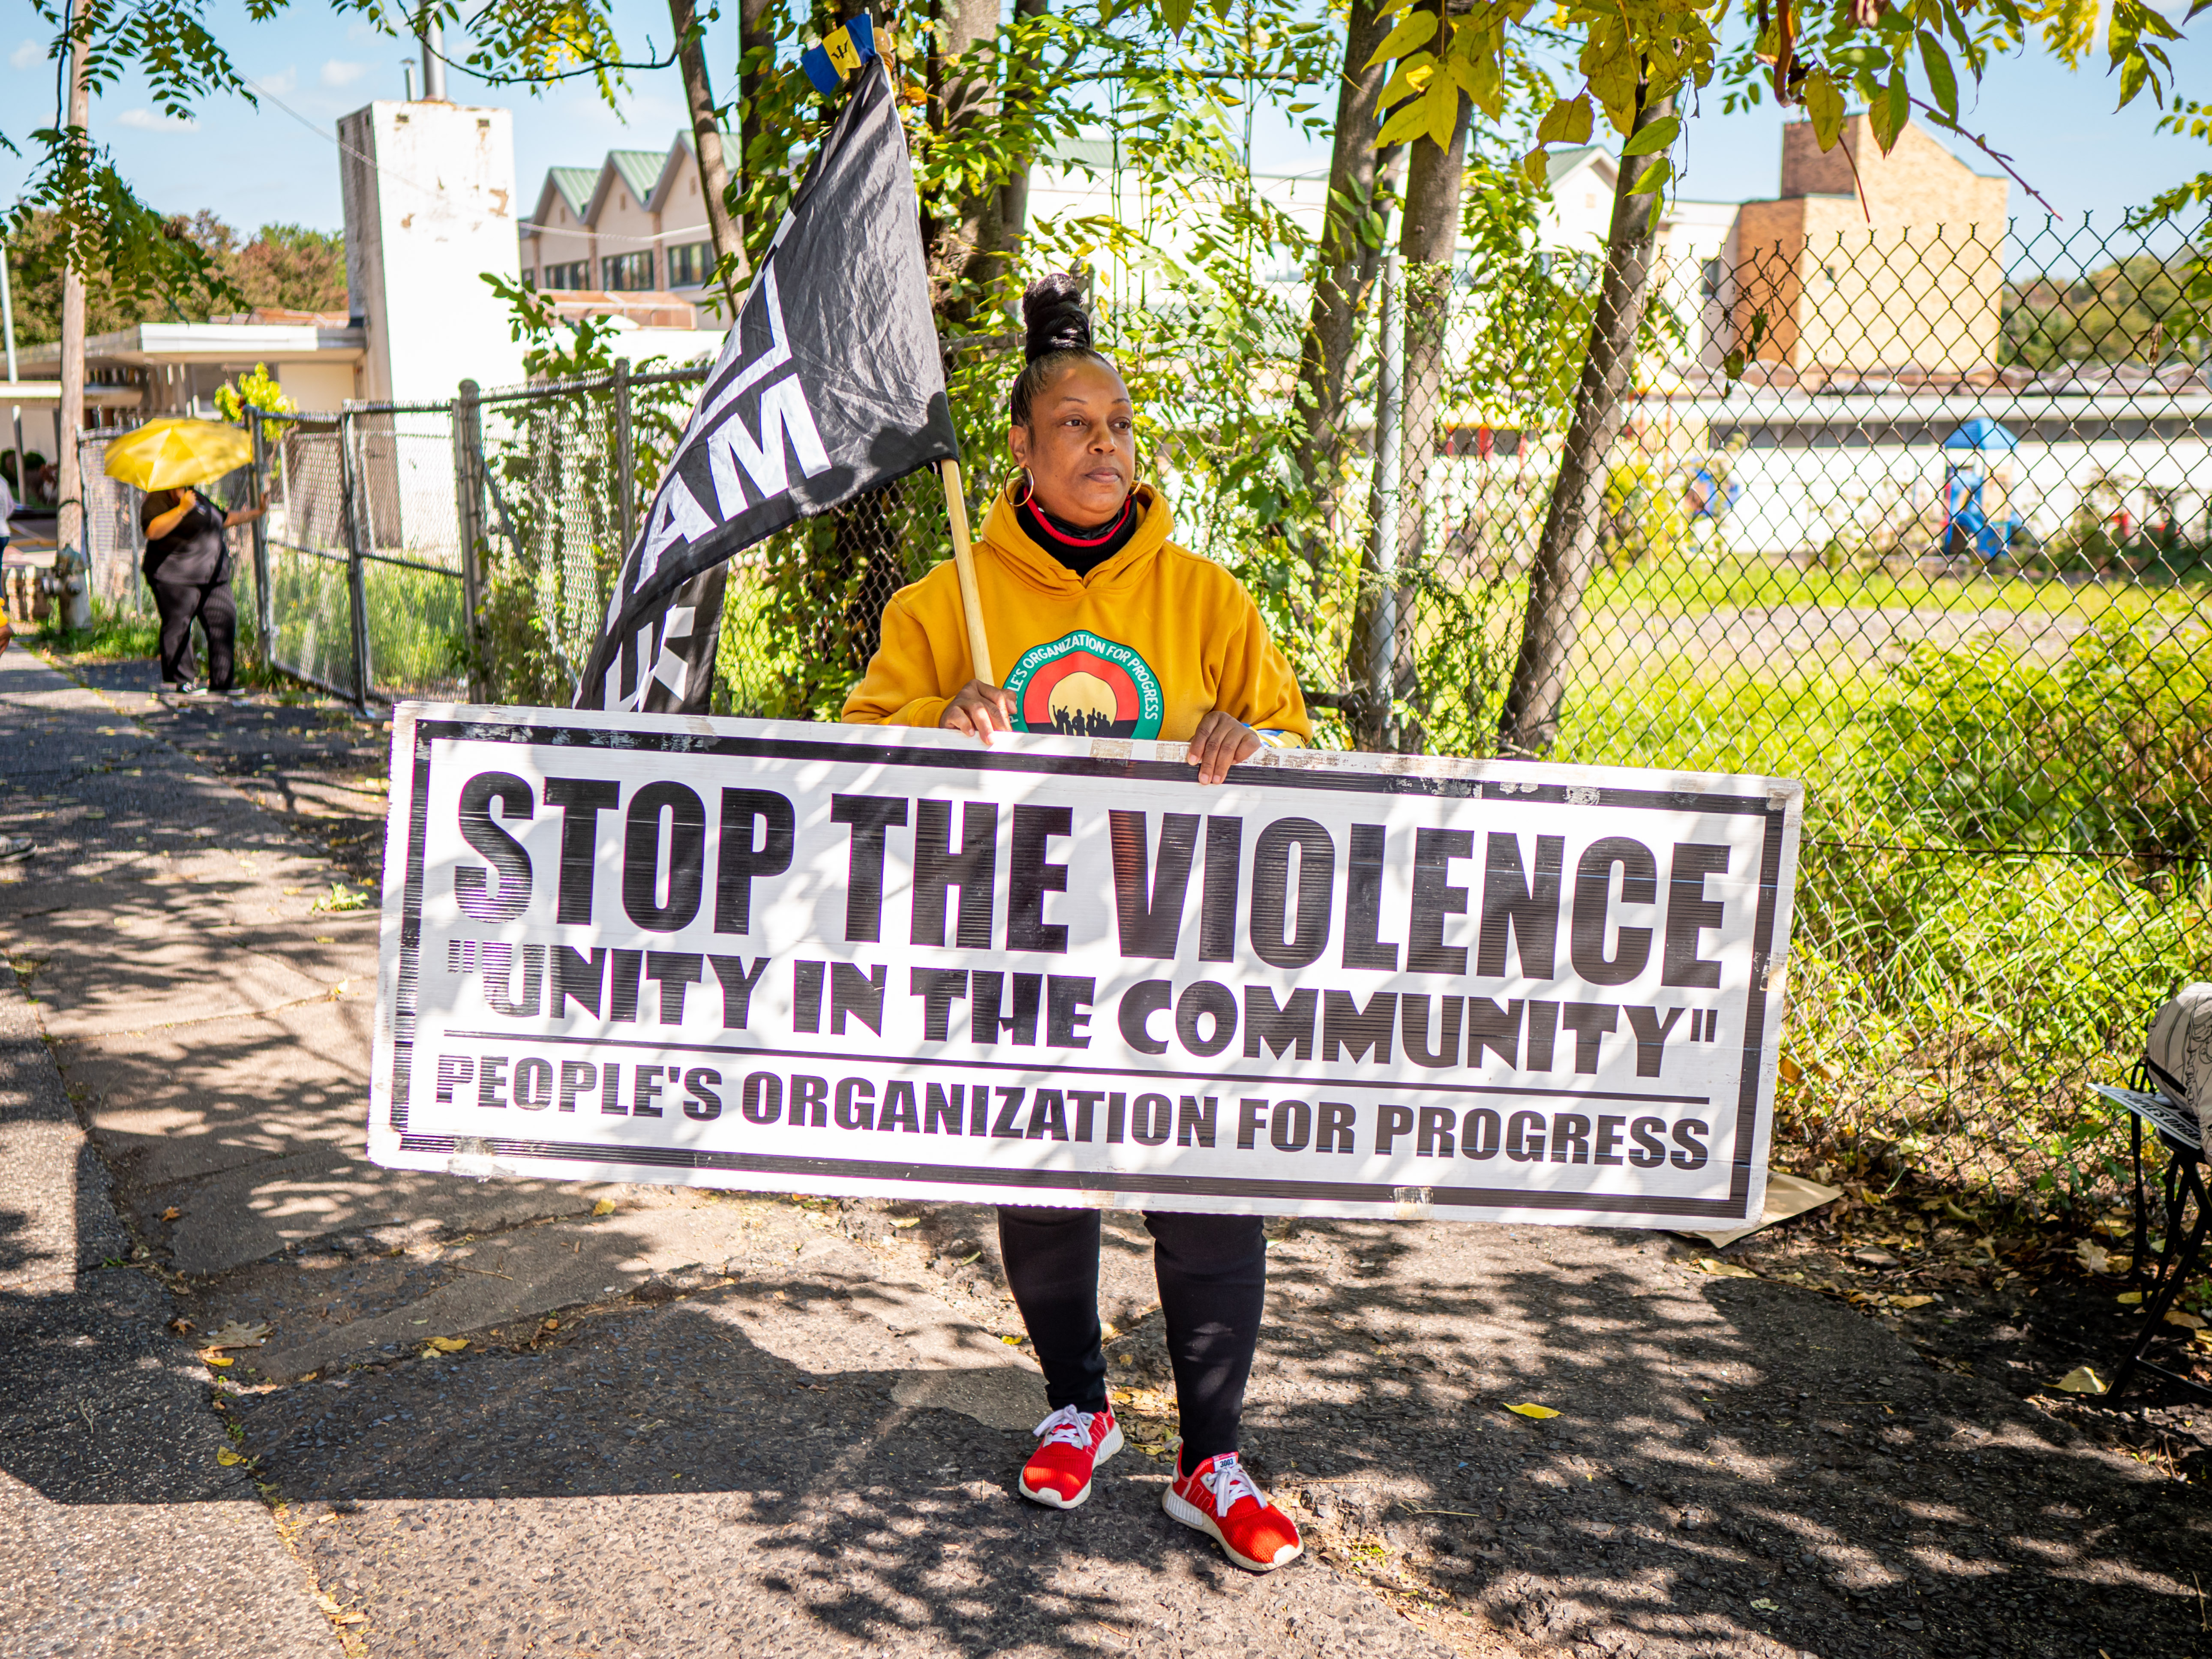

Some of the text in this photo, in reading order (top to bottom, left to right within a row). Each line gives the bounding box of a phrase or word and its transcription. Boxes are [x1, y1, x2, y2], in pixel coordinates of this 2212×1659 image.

[1007, 634, 1159, 723] PLE'S ORGANIZATION FOR PROGRESS
[454, 771, 1731, 989] STOP THE VIOLENCE
[447, 939, 1718, 1078] "UNITY IN THE COMMUNITY"
[435, 1053, 1710, 1170] PEOPLE'S ORGANIZATION FOR PROGRESS
[1220, 1458, 1234, 1468] 3003
